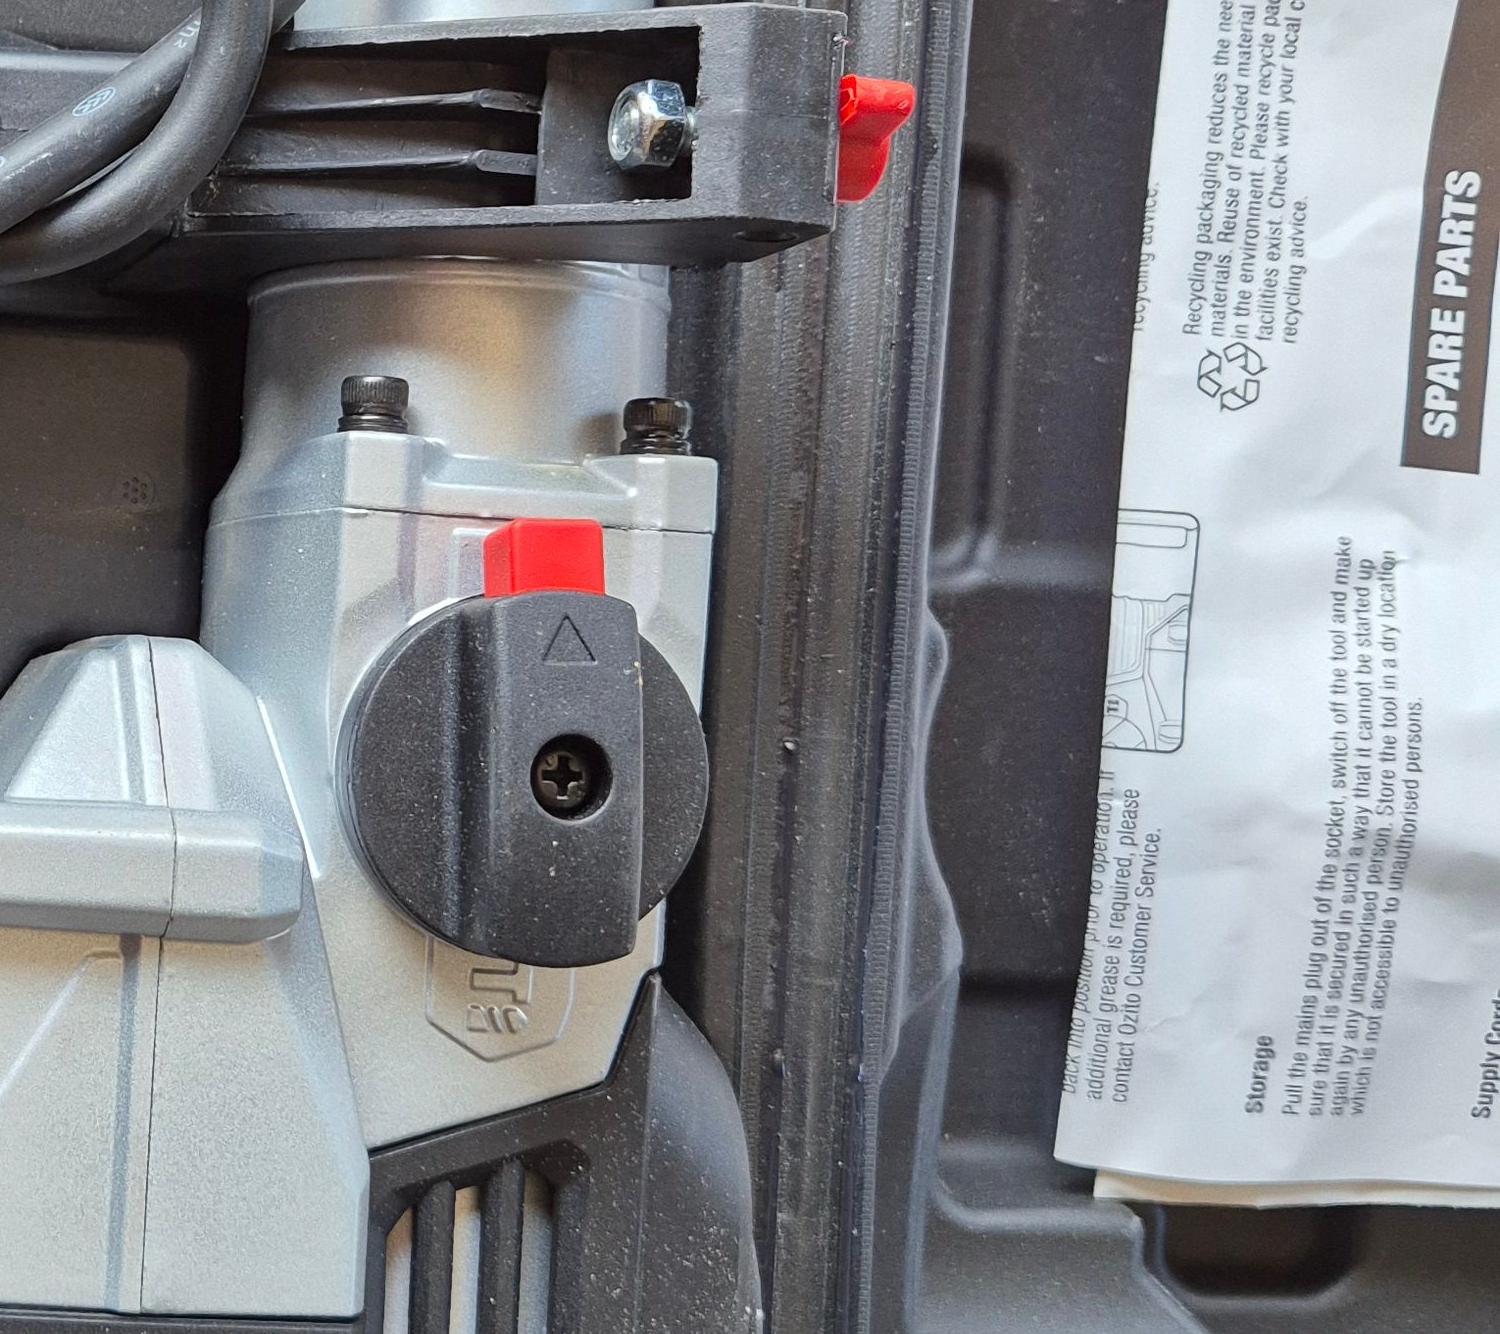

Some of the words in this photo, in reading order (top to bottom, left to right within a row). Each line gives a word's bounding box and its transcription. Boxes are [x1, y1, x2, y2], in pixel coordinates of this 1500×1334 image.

[1212, 39, 1231, 66] the
[1235, 4, 1257, 78] material
[1278, 16, 1303, 60] local
[1256, 33, 1276, 96] recycle
[1279, 63, 1302, 104] your
[1205, 72, 1228, 144] reduces
[1229, 84, 1251, 159] recycled
[1250, 102, 1271, 160] Please
[1272, 110, 1291, 148] with
[1225, 164, 1242, 182] of
[1267, 153, 1289, 209] Check
[1196, 151, 1224, 245] packaging
[1217, 188, 1241, 243] Reuse
[1239, 166, 1266, 284] environment.
[1263, 216, 1284, 262] exist.
[1289, 195, 1309, 259] advice.
[1432, 170, 1481, 298] PARTS
[1181, 250, 1213, 335] Recycling
[1210, 248, 1234, 338] materials.
[1233, 290, 1252, 317] the
[1254, 267, 1280, 342] facilities
[1281, 264, 1307, 345] recycling
[1233, 323, 1249, 340] in
[1422, 308, 1465, 439] SPARE
[1333, 536, 1353, 585] make
[1357, 558, 1377, 582] up
[1328, 590, 1348, 625] and
[1376, 550, 1397, 619] location
[1351, 586, 1372, 648] started
[1377, 623, 1402, 652] dry
[1327, 629, 1349, 662] tool
[1352, 653, 1373, 675] be
[1382, 658, 1398, 670] a
[1327, 667, 1348, 695] the
[1377, 674, 1398, 690] in
[1327, 700, 1349, 725] off
[1354, 680, 1375, 742] cannot
[1377, 696, 1398, 729] tool
[1352, 747, 1372, 758] it
[1376, 734, 1398, 763] the
[1401, 697, 1427, 773] persons.
[1327, 730, 1350, 788] switch
[1351, 764, 1373, 799] that
[1374, 769, 1396, 817] Store
[1120, 788, 1141, 846] please
[1323, 795, 1350, 858] socket,
[1351, 804, 1376, 842] way
[1382, 777, 1423, 892] unauthorised
[1134, 828, 1162, 898] Service.
[1347, 846, 1365, 857] a
[1364, 822, 1393, 885] person.
[1106, 852, 1137, 930] required,
[1315, 864, 1338, 891] the
[1338, 862, 1360, 905] such
[1312, 895, 1333, 914] of
[1334, 909, 1355, 926] in
[1380, 896, 1401, 915] to
[1102, 935, 1123, 950] is
[1123, 902, 1153, 987] Customer
[1309, 918, 1331, 947] out
[1348, 890, 1380, 1004] unauthorised
[1098, 955, 1121, 1013] grease
[1302, 952, 1329, 988] plug
[1324, 930, 1351, 1000] secured
[1368, 919, 1397, 1010] accessible
[1116, 993, 1142, 1036] Ozito
[1293, 994, 1318, 1047] mains
[1317, 1024, 1337, 1035] it
[1320, 1005, 1339, 1019] is
[1341, 1008, 1365, 1040] any
[1363, 1014, 1383, 1042] not
[1084, 1017, 1112, 1101] additional
[1110, 1041, 1136, 1103] contact
[1243, 1035, 1276, 1114] Storage
[1286, 1051, 1308, 1079] the
[1312, 1040, 1335, 1075] that
[1335, 1044, 1358, 1065] by
[1359, 1047, 1377, 1061] is
[1280, 1084, 1303, 1115] Pull
[1306, 1079, 1328, 1117] sure
[1328, 1070, 1351, 1117] again
[1349, 1066, 1373, 1116] which
[1470, 1051, 1500, 1119] Supply
